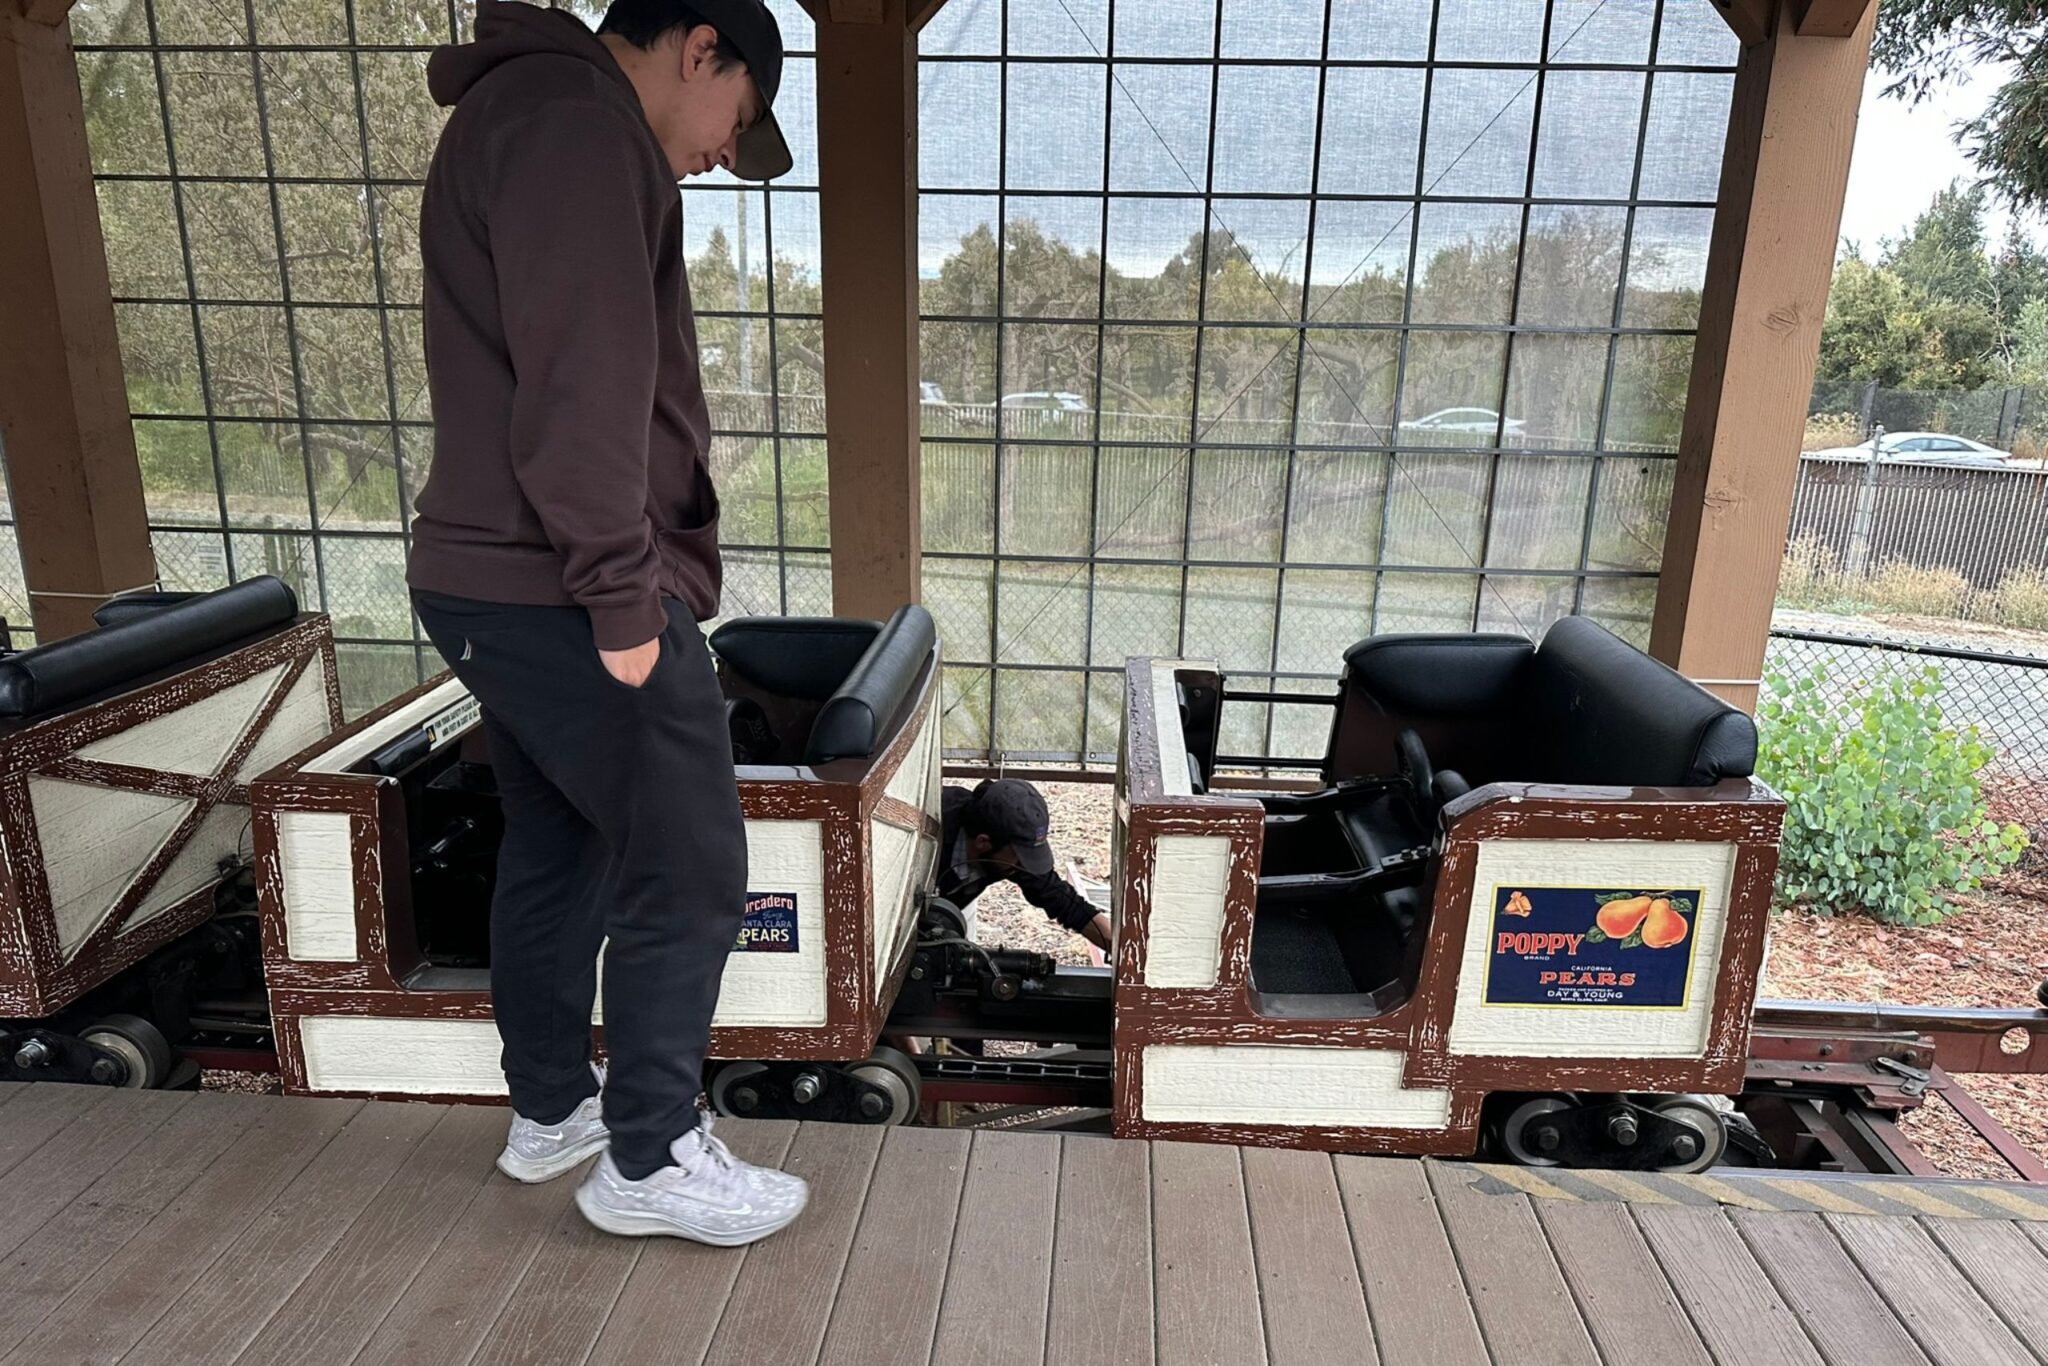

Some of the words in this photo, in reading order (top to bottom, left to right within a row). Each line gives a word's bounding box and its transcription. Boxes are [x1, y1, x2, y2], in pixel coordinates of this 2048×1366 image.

[741, 920, 763, 928] ANTA
[764, 920, 793, 929] CLARA
[741, 928, 790, 942] PEARS
[1496, 932, 1585, 955] POPPY
[1539, 971, 1636, 986] PEARS
